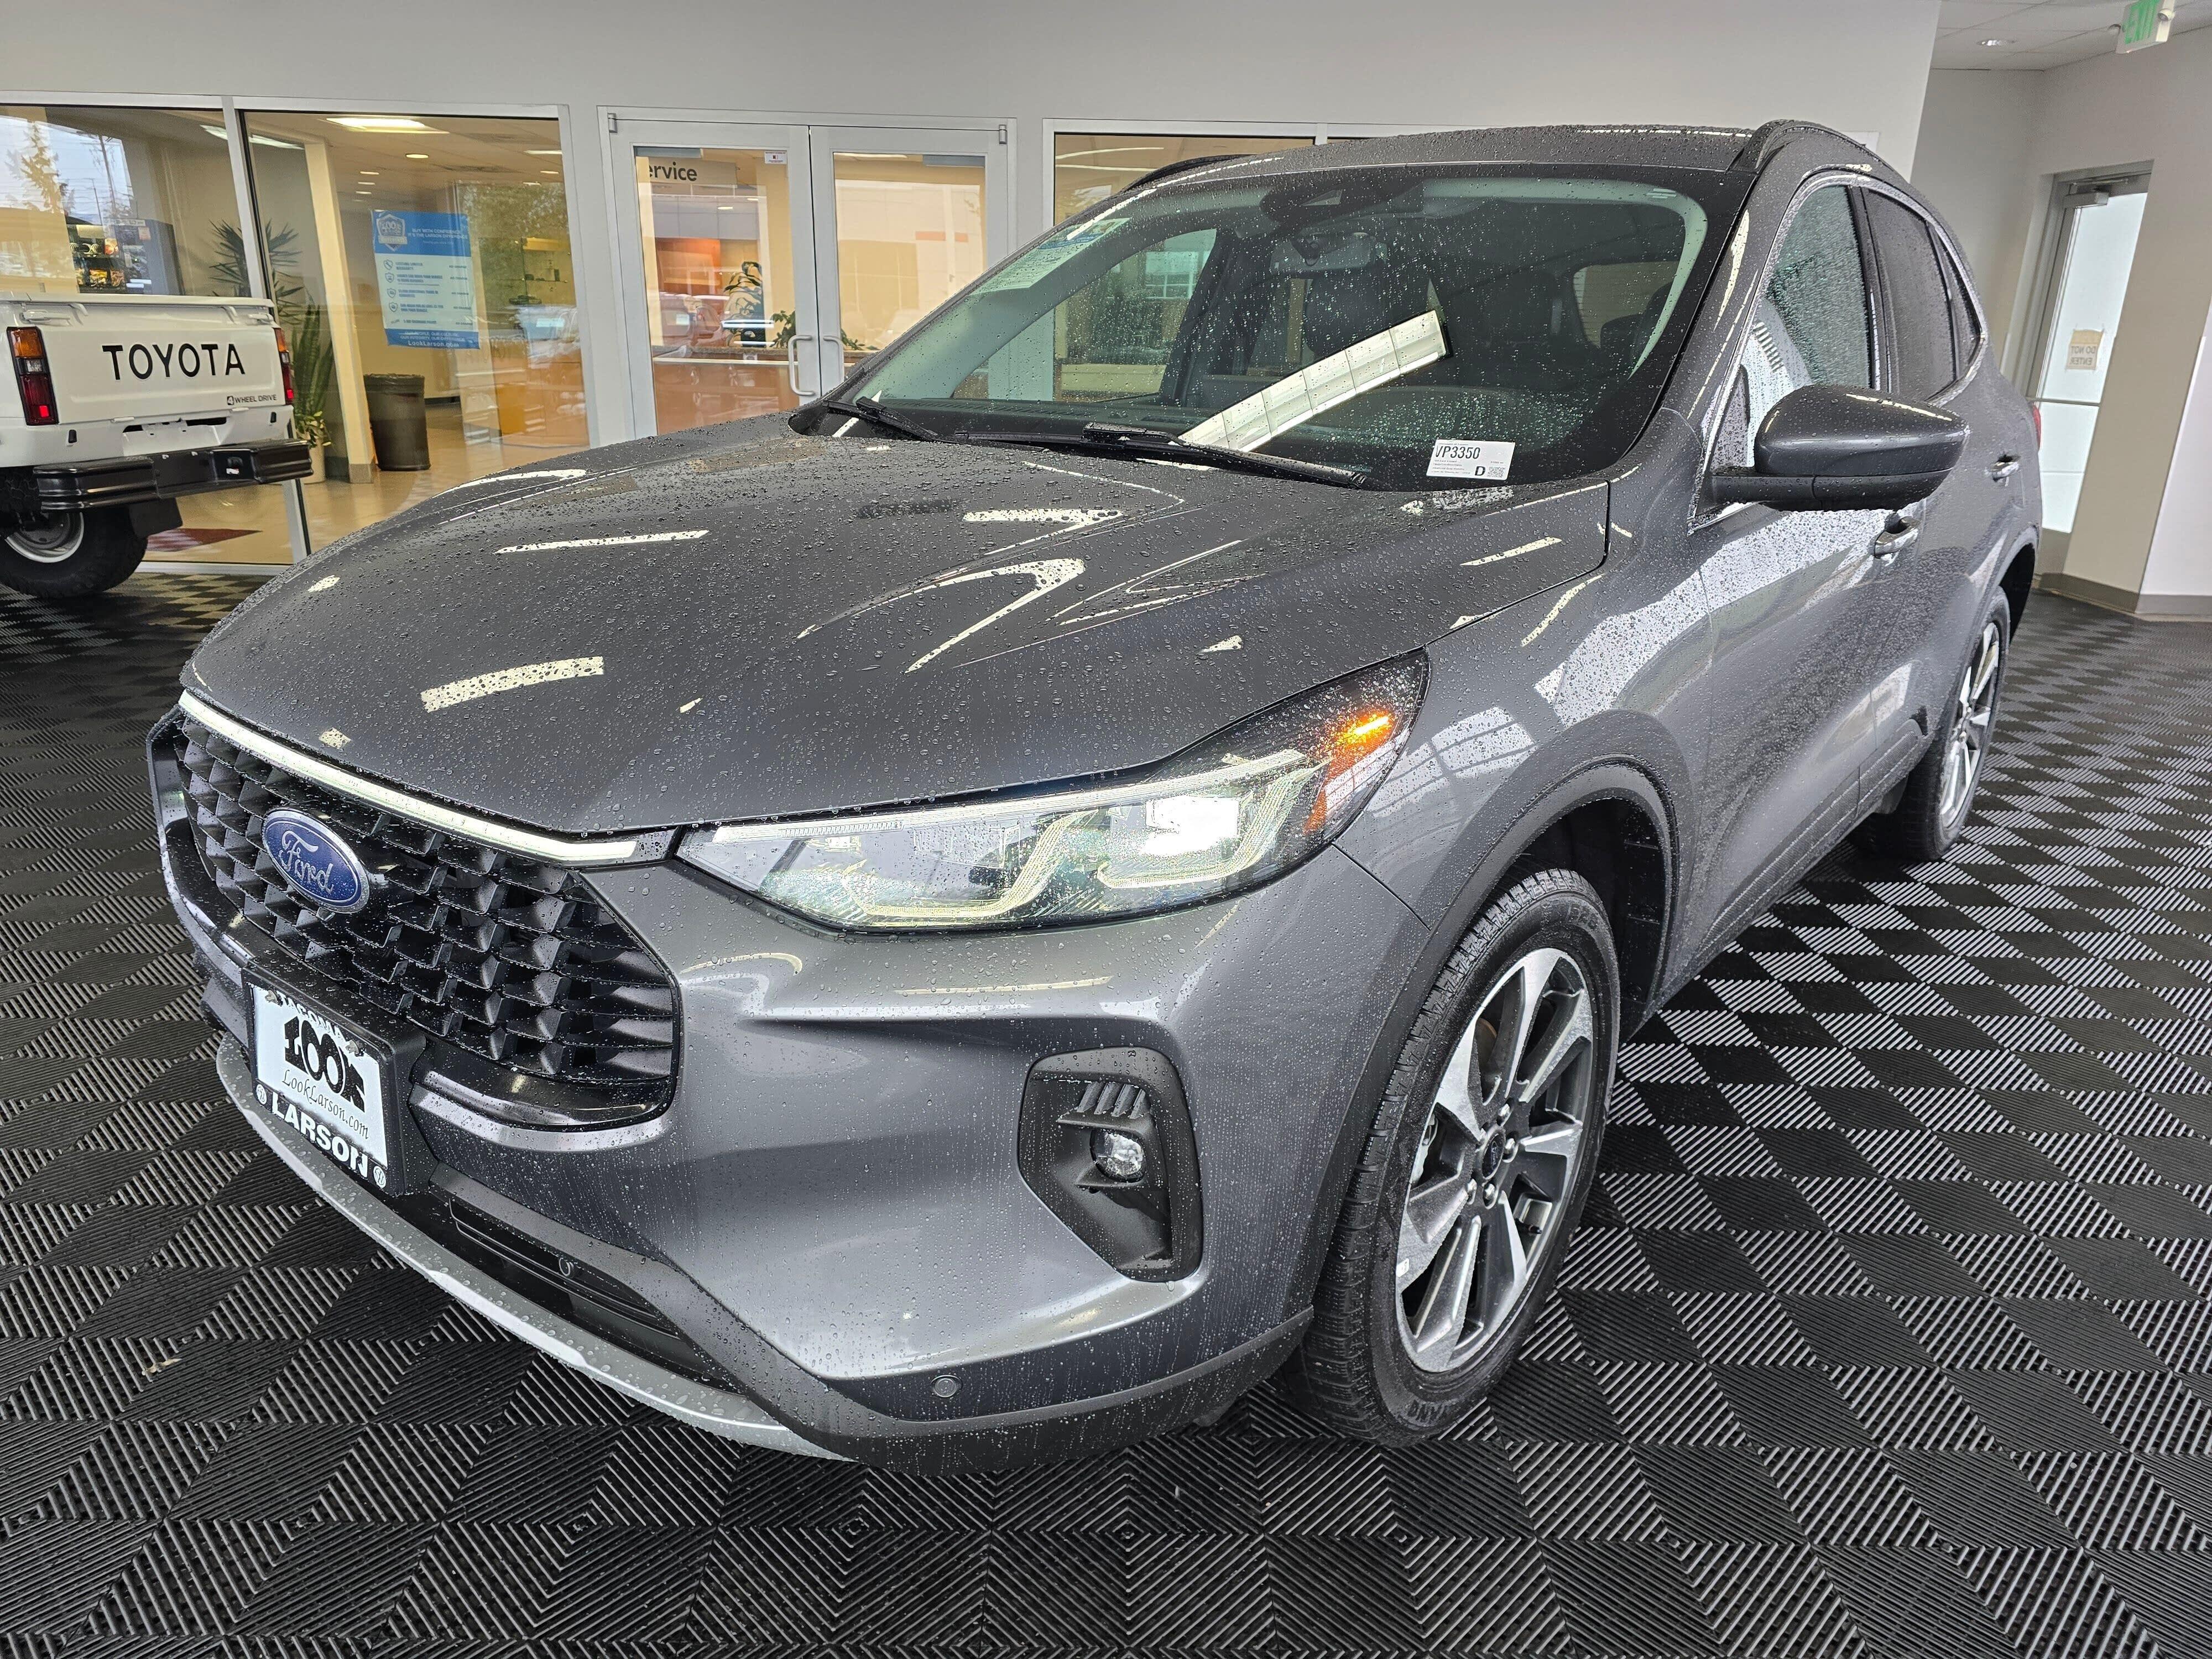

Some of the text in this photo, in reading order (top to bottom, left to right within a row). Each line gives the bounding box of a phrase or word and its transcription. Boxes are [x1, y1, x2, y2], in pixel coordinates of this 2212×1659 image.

[102, 343, 245, 380] TOYOTA
[1436, 446, 1480, 459] VP3350
[1475, 466, 1486, 476] D
[278, 831, 334, 894] Ford
[283, 1070, 369, 1139] LookLarson.com
[272, 1092, 368, 1178] LARSON
